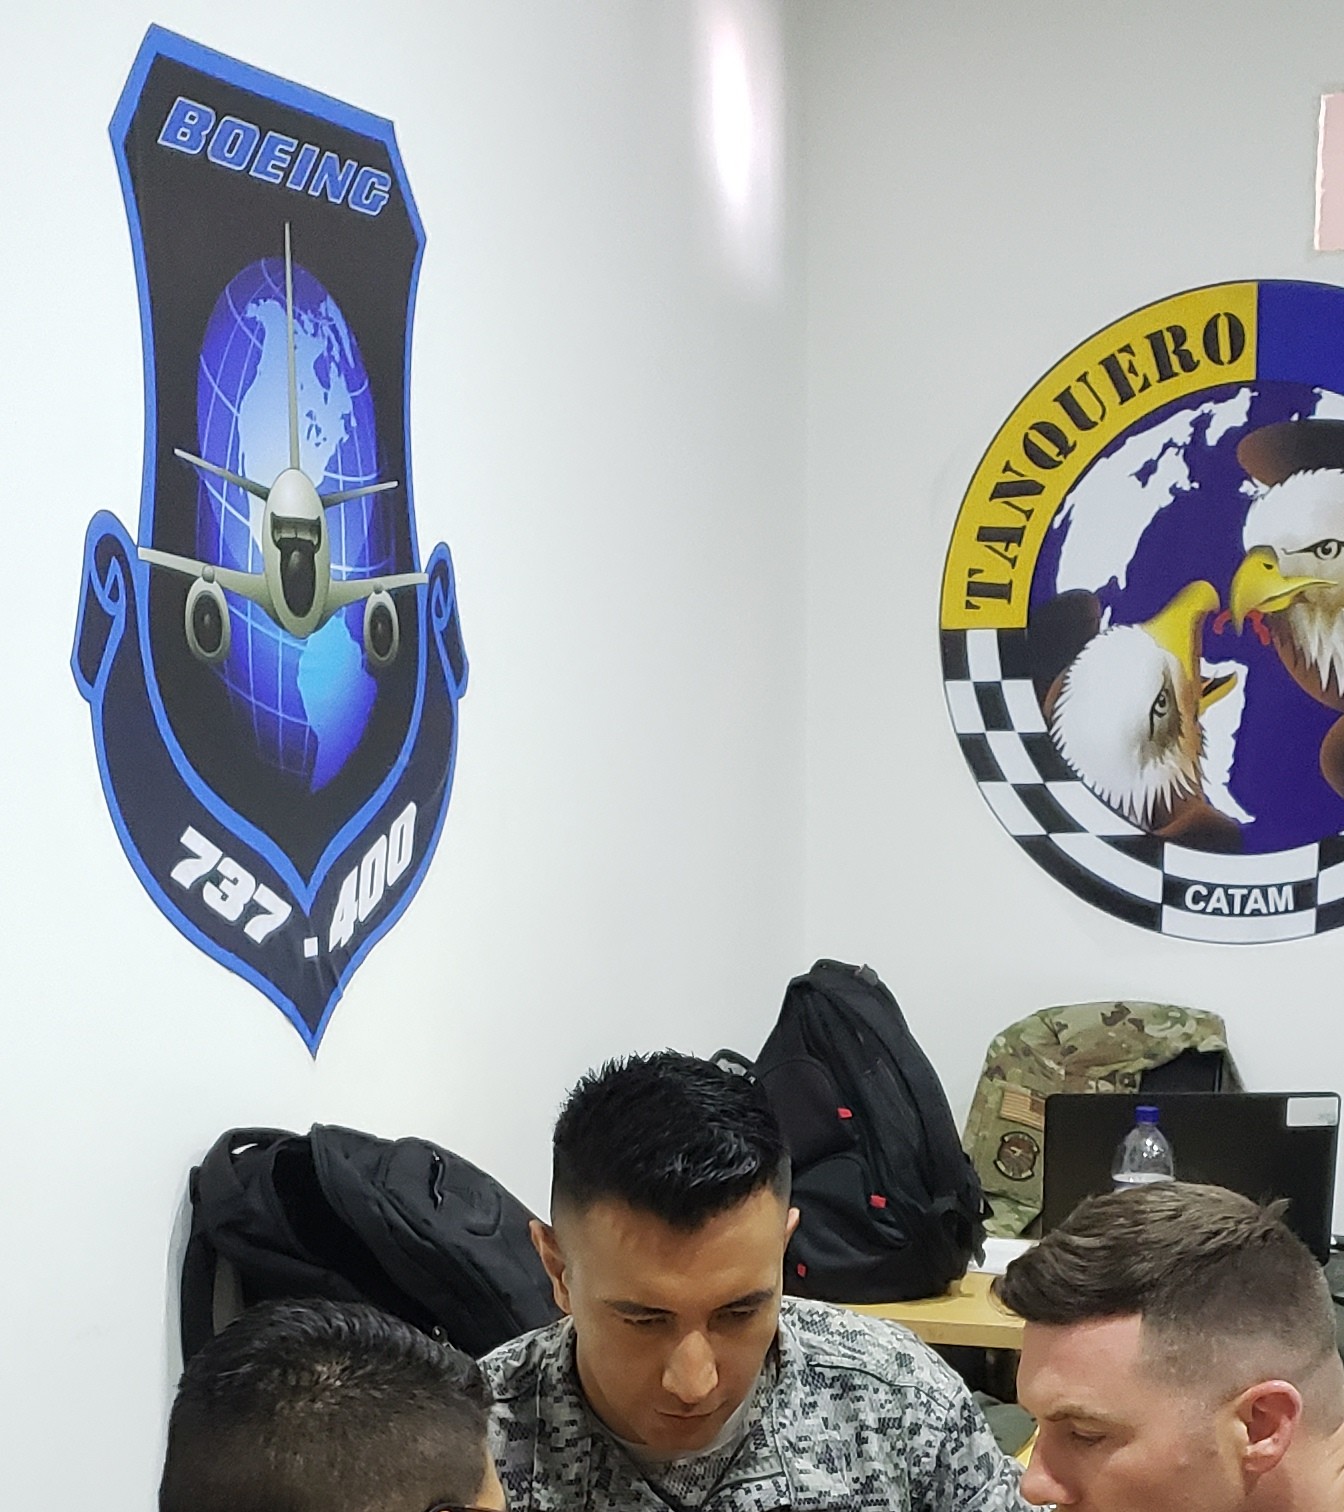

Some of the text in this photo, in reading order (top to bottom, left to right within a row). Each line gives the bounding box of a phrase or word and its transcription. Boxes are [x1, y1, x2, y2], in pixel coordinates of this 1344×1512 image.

[158, 94, 393, 217] BOEING
[964, 311, 1249, 612] TANQUERO
[1184, 883, 1295, 917] CATAM
